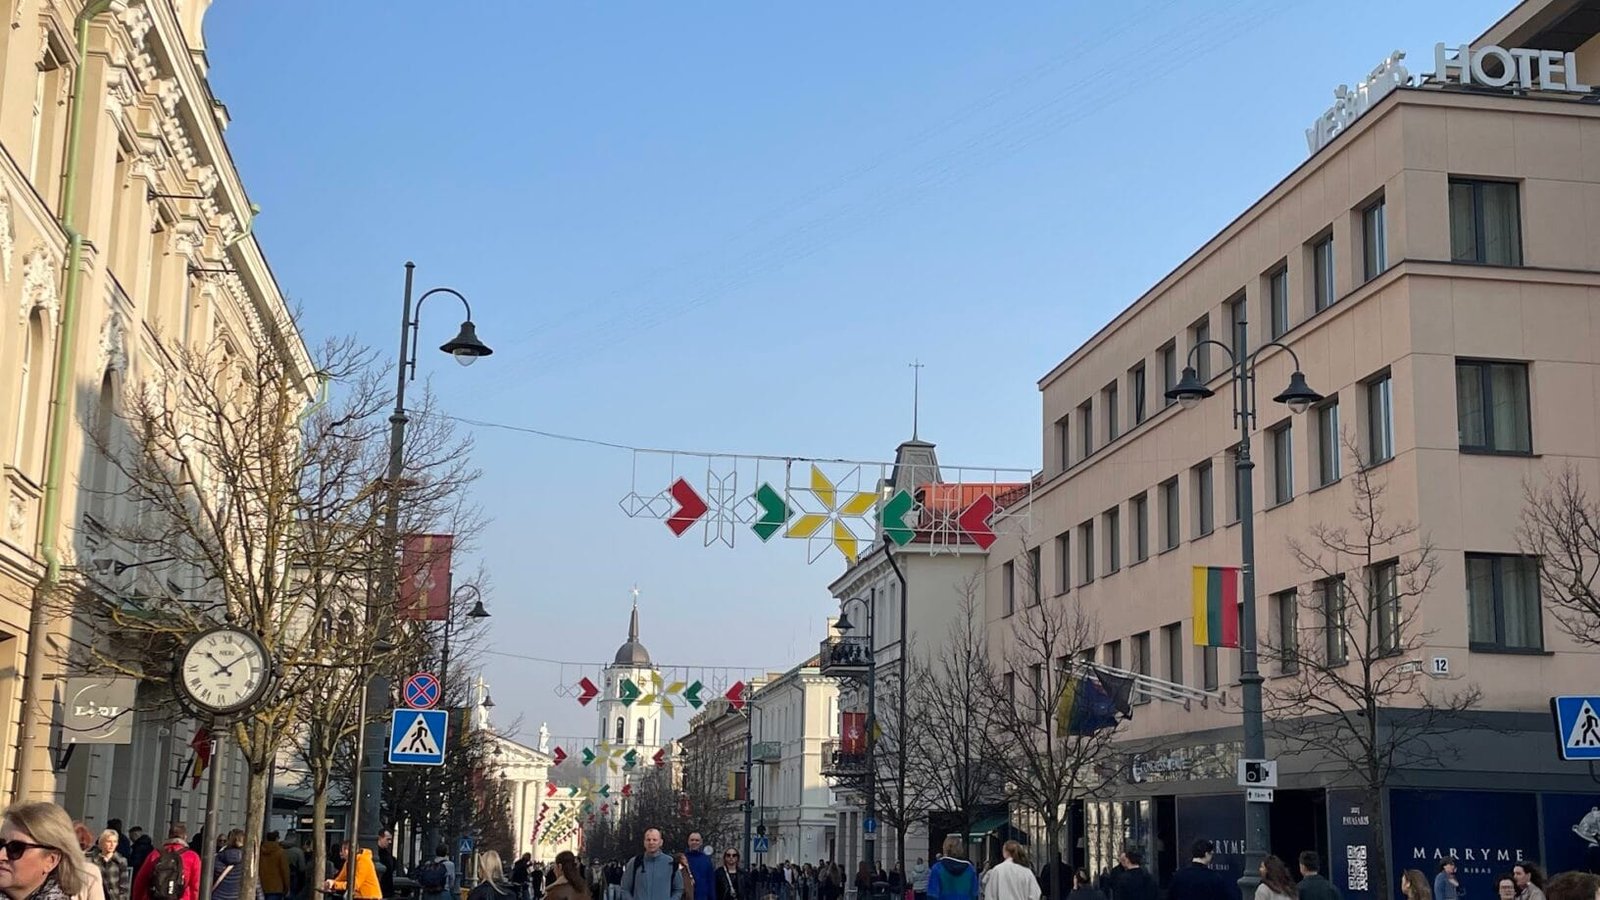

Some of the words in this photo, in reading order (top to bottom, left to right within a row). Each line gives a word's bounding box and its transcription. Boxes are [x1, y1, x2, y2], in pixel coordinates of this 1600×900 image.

[1434, 42, 1591, 93] HOTEL
[1435, 659, 1447, 672] 12
[1208, 839, 1246, 855] RYME
[1413, 846, 1524, 862] MARRYME
[1463, 866, 1492, 874] RIBAS
